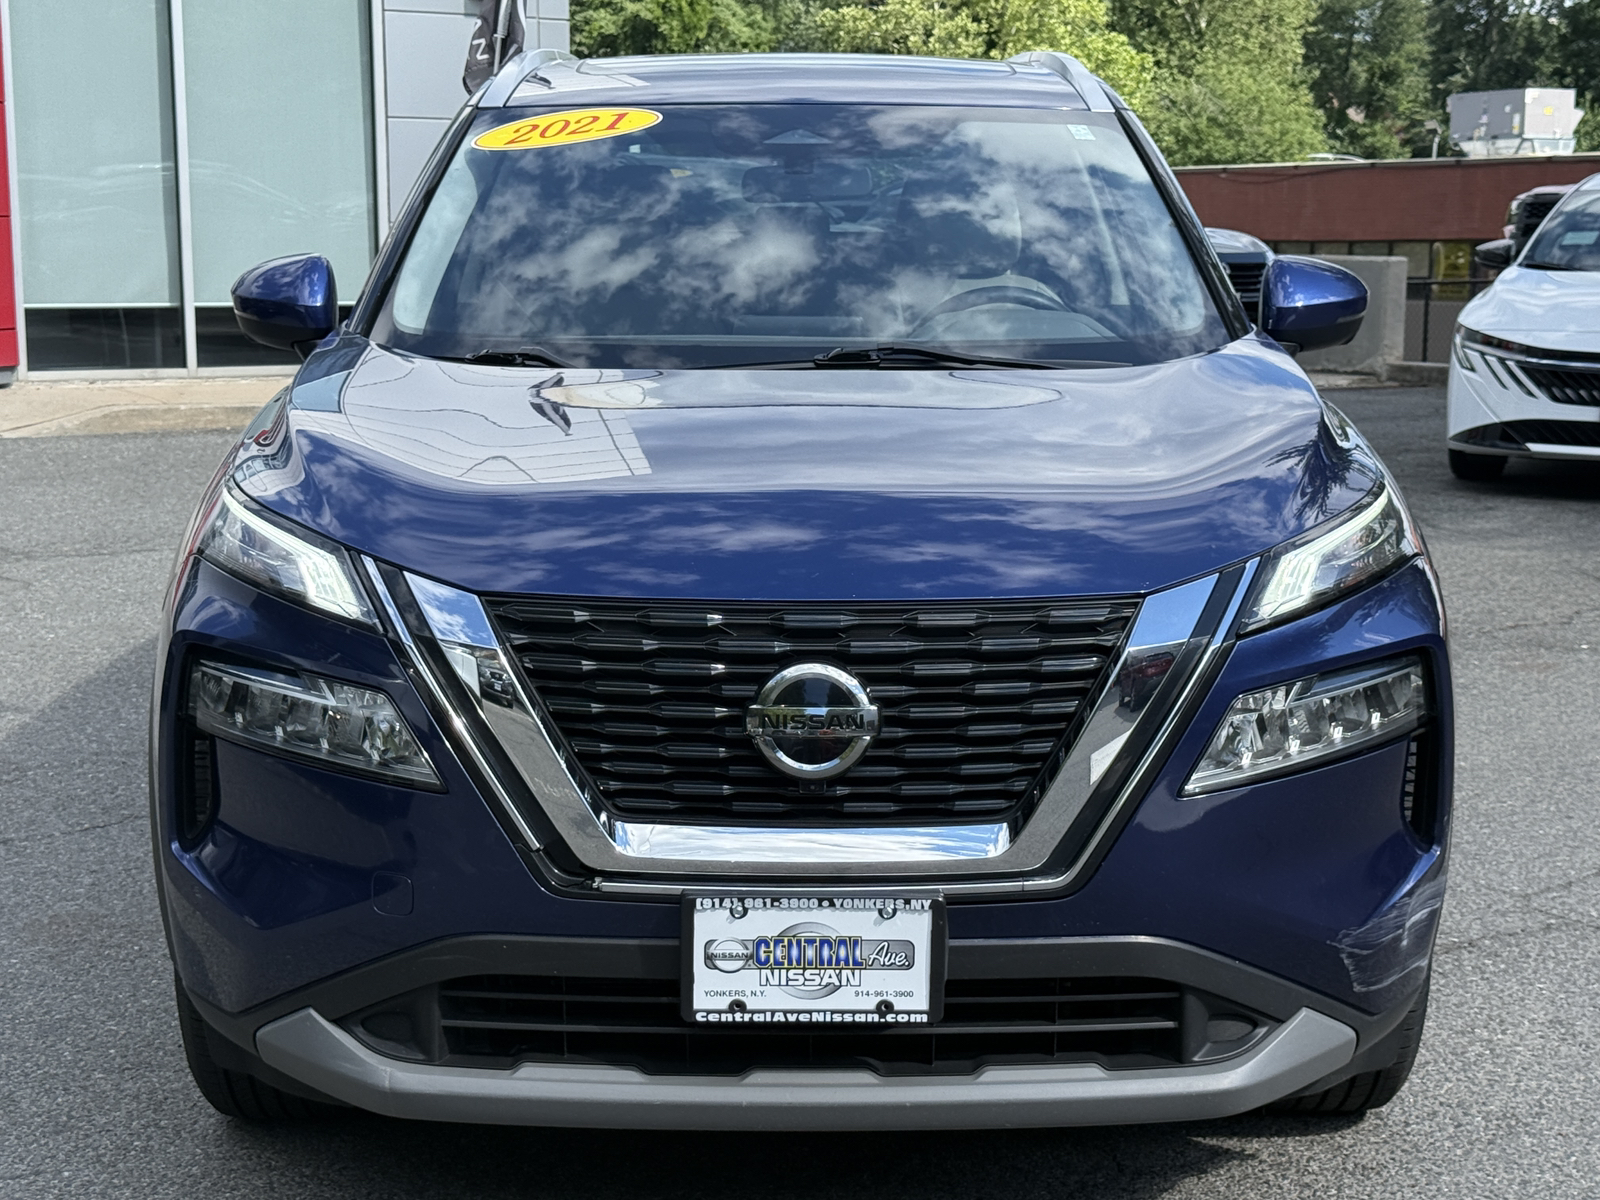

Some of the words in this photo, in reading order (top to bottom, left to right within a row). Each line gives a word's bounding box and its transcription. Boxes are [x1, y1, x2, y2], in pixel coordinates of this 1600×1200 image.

[503, 112, 629, 146] 2021
[761, 714, 865, 730] NISSAN
[744, 898, 819, 909] 961-3900
[753, 936, 867, 969] CENTRAL
[868, 941, 910, 967] Ave.
[760, 969, 861, 986] NISSAN
[704, 990, 749, 998] YONKERS,
[854, 990, 914, 998] 914-961-3900
[695, 1012, 928, 1023] CentralAveNissan.com
